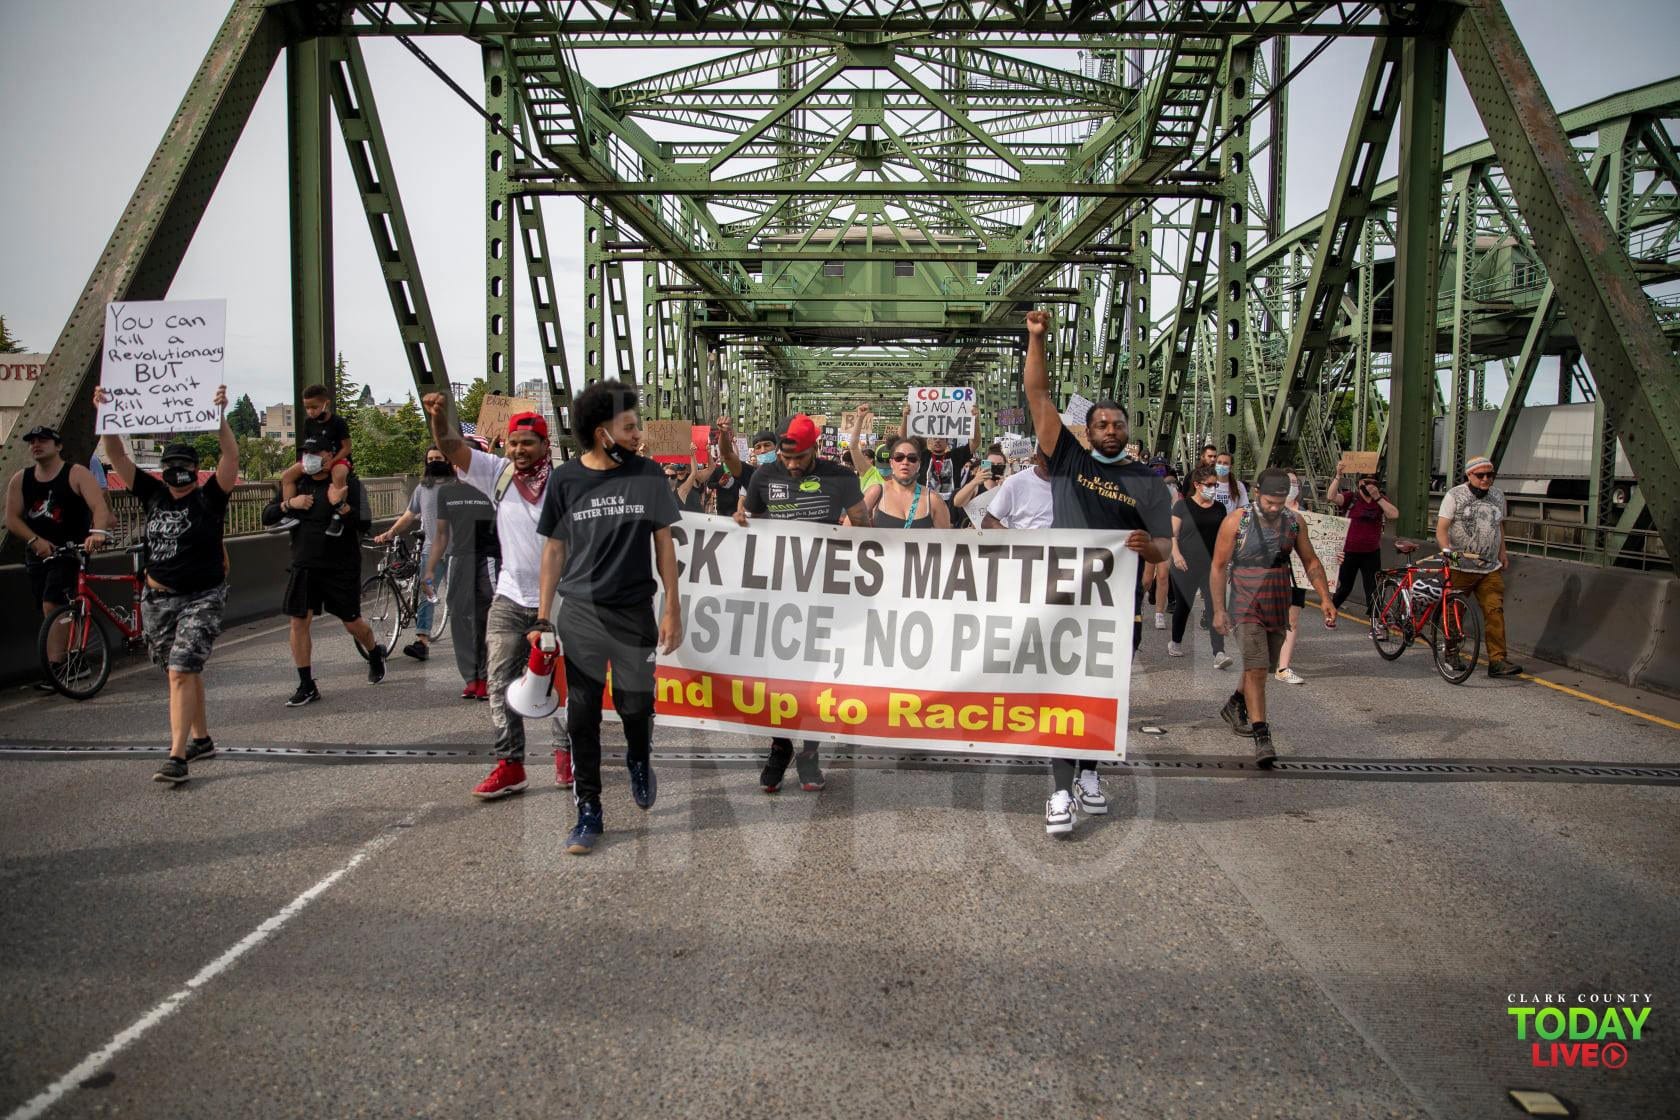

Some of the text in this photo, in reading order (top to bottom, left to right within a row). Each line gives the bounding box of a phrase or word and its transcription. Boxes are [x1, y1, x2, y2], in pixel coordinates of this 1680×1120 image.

[135, 361, 184, 383] BUT
[162, 397, 195, 408] the
[917, 388, 973, 401] COLOR
[916, 401, 967, 414] IS NOT A
[911, 415, 972, 435] CRIME
[591, 495, 625, 507] BLACK &
[1119, 493, 1137, 507] EVER
[572, 504, 645, 521] BETTER THAN EVER
[741, 534, 885, 598] LIVES
[902, 541, 1115, 607] MATTER
[863, 608, 934, 670] NO
[950, 613, 1117, 679] PEACE
[731, 679, 799, 725] Up
[816, 688, 868, 724] to
[888, 692, 1086, 737] Racism
